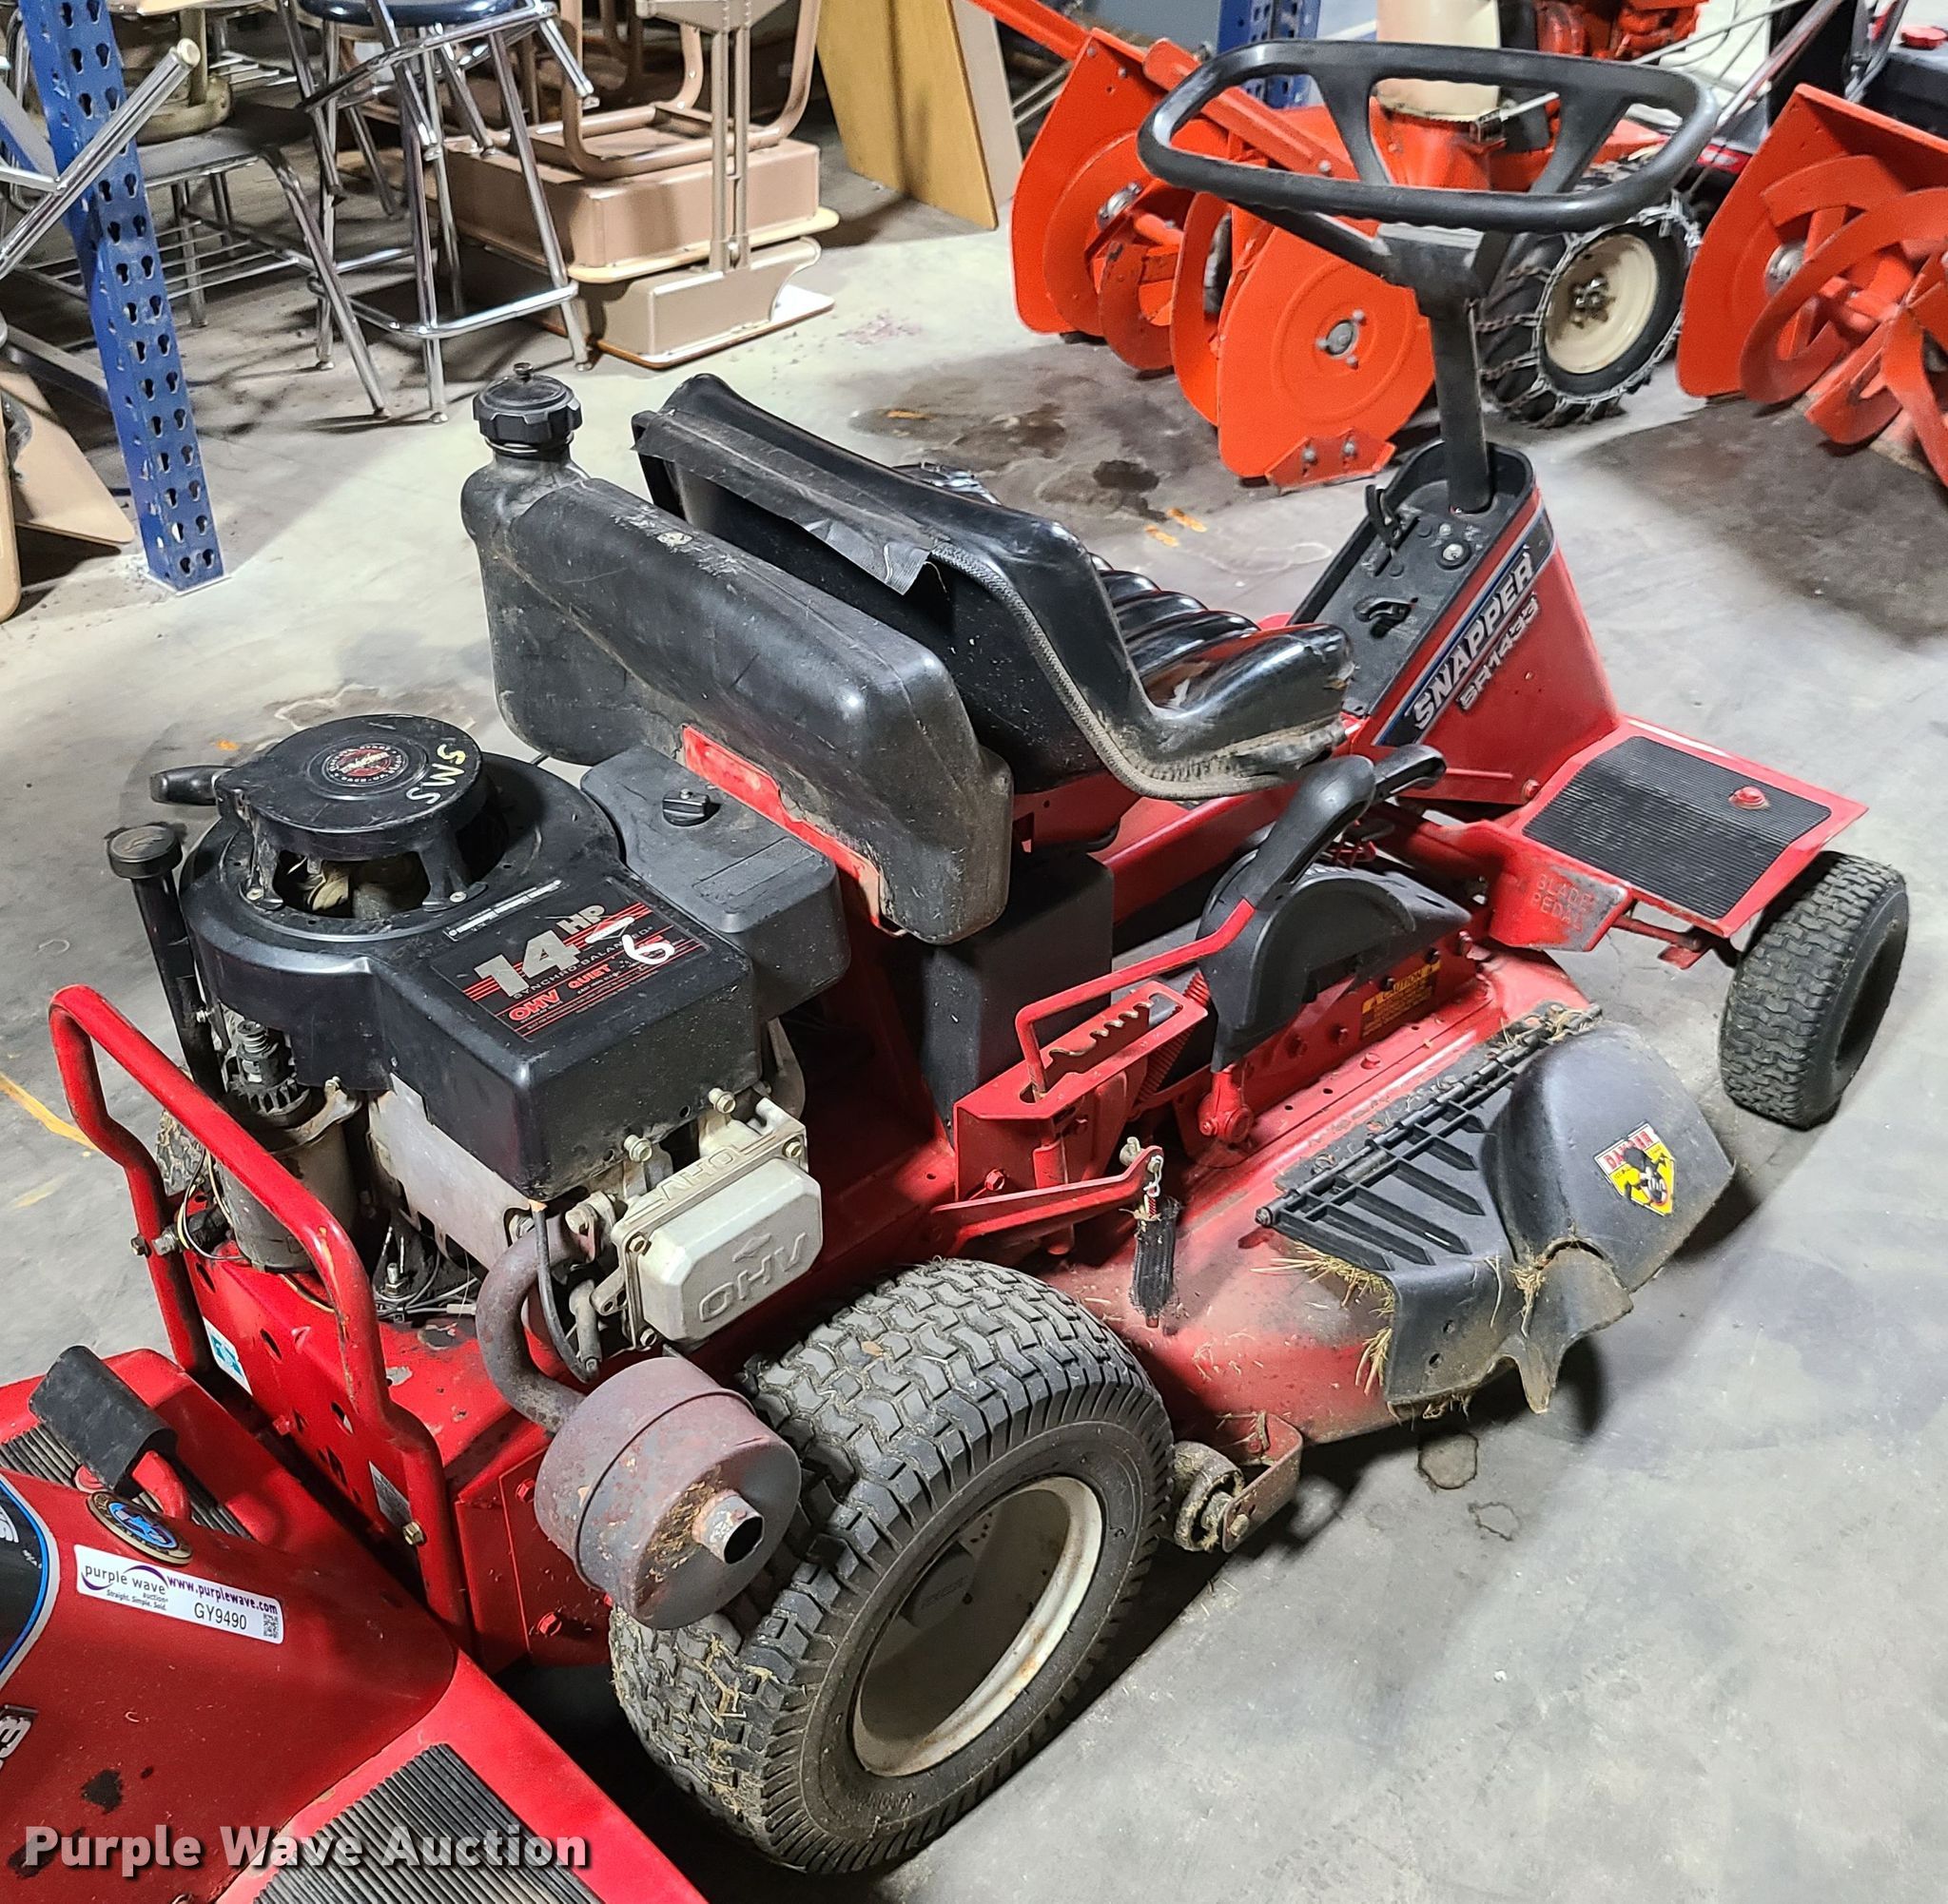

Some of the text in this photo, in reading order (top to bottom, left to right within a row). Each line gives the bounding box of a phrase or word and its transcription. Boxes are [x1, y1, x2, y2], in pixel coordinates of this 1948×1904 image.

[1412, 546, 1534, 730] SNAPPER
[474, 929, 581, 998] 14
[556, 904, 607, 935] HP
[514, 926, 648, 1000] SYNCHRO-BALANED
[622, 934, 675, 964] 6
[508, 989, 560, 1021] OHV
[567, 963, 611, 989] QUIET
[1603, 1130, 1653, 1171] DAER
[698, 1232, 808, 1322] OHV
[85, 1564, 166, 1595] purple wave
[166, 1575, 278, 1615] www.purplewave.com
[194, 1602, 247, 1630] GY9490
